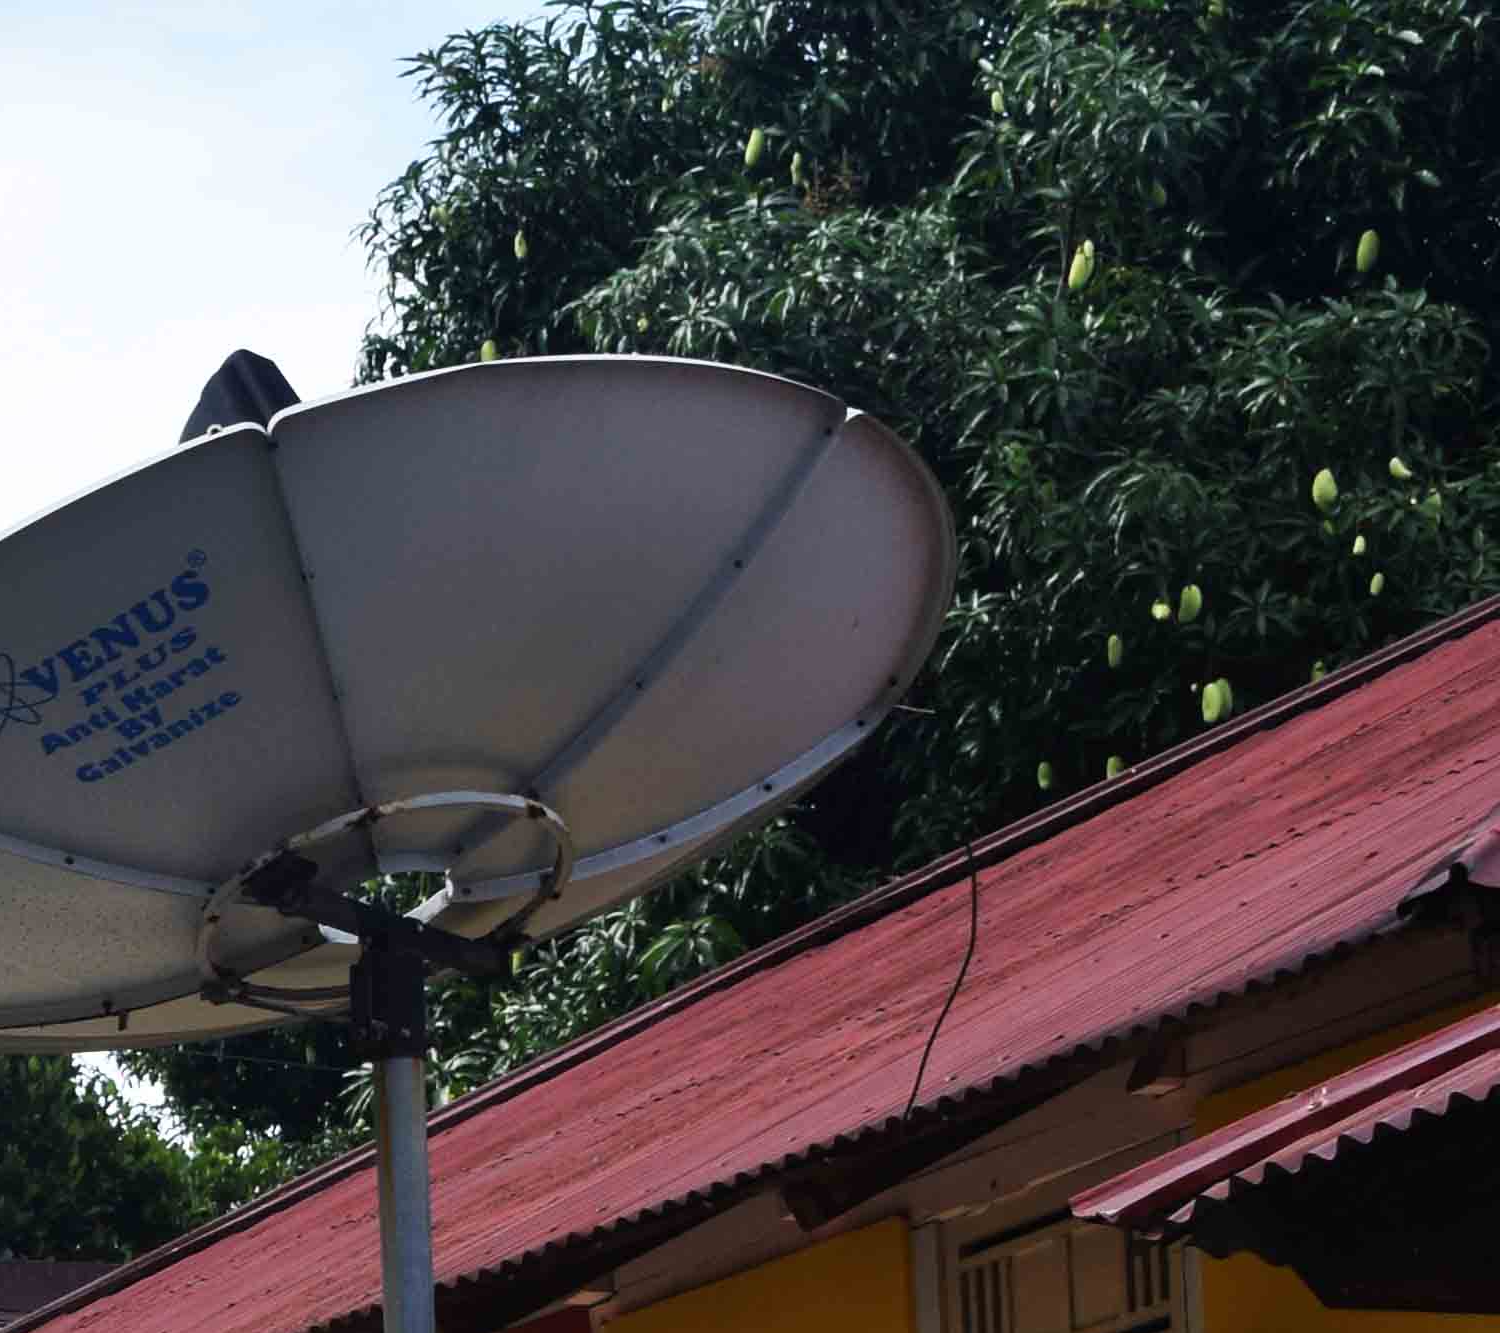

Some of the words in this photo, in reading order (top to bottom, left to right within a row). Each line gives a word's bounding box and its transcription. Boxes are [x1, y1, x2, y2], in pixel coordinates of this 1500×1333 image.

[81, 624, 197, 707] PLUS
[41, 704, 119, 755] Anti
[75, 690, 242, 783] Galvanize
[116, 705, 163, 741] By
